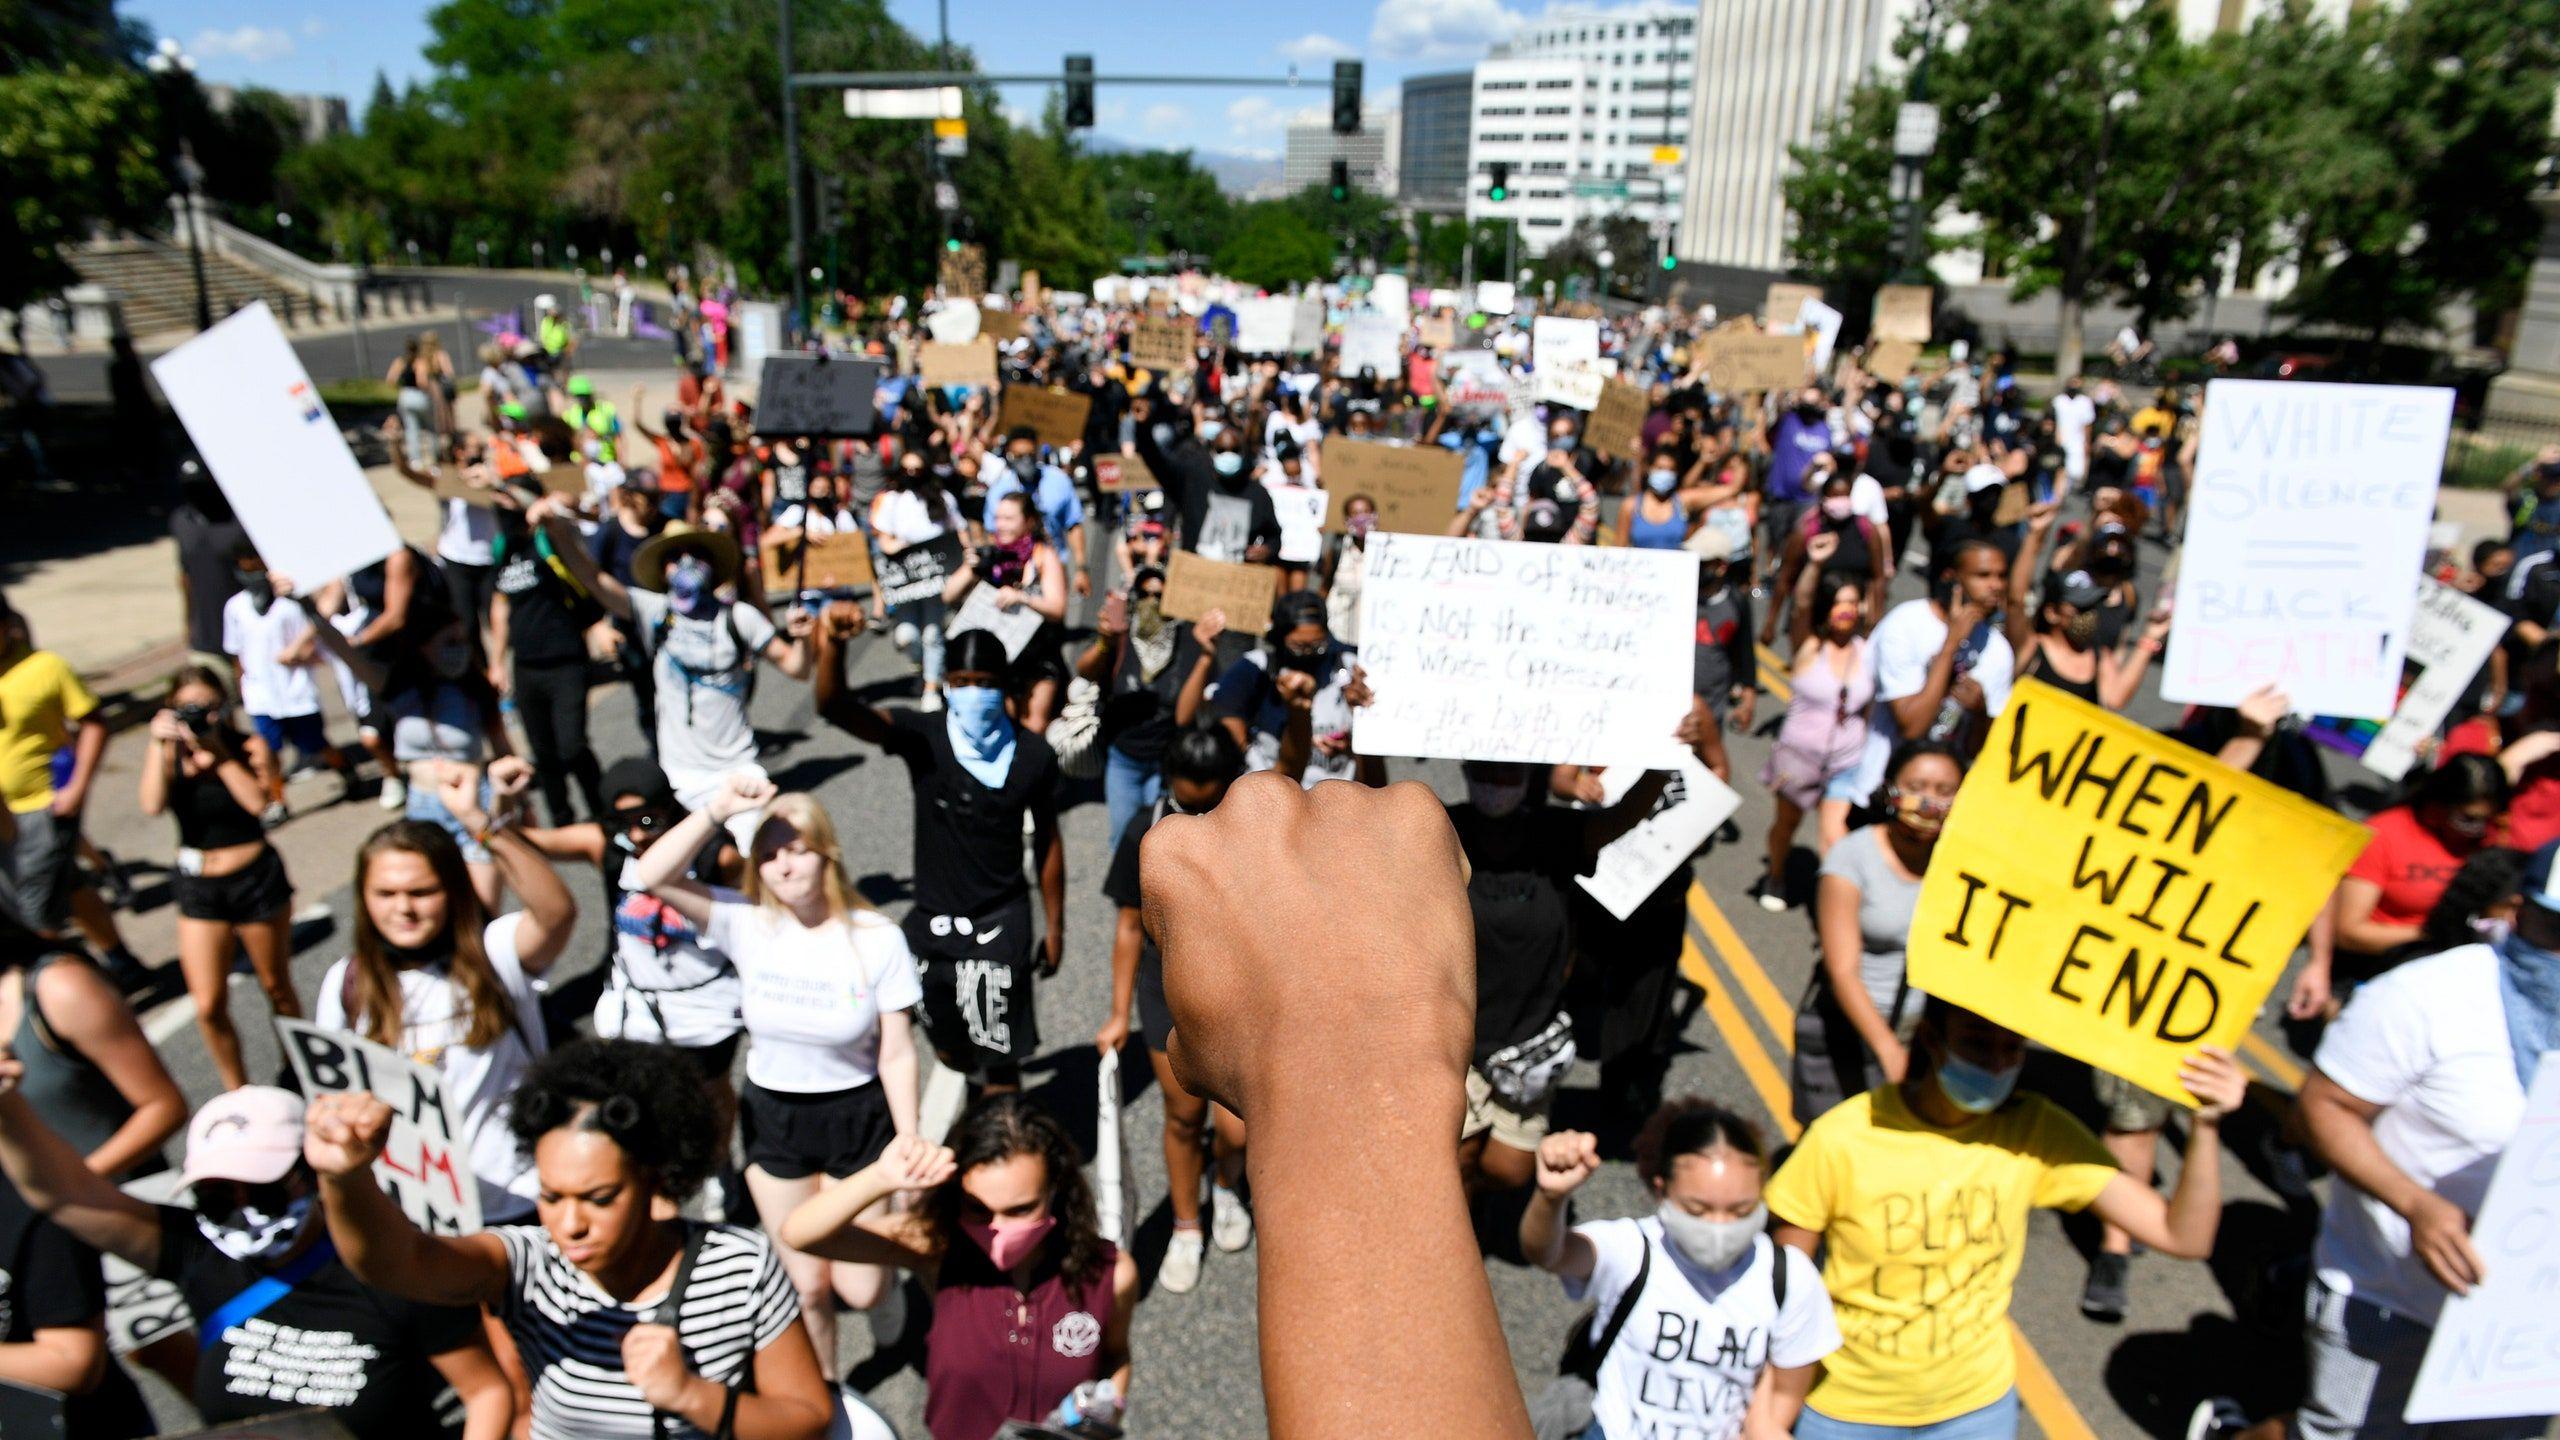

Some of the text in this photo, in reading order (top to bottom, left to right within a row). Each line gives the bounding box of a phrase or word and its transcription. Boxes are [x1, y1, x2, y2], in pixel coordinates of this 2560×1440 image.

[2219, 397, 2426, 460] WHITE
[2203, 468, 2425, 521] SILENCE
[1421, 540, 1504, 585] END
[2190, 578, 2389, 623] BLACK
[2185, 627, 2393, 687] DEATH!
[2008, 702, 2241, 856] WHEN
[2071, 834, 2264, 970] WILL
[1943, 871, 2221, 1045] IT END
